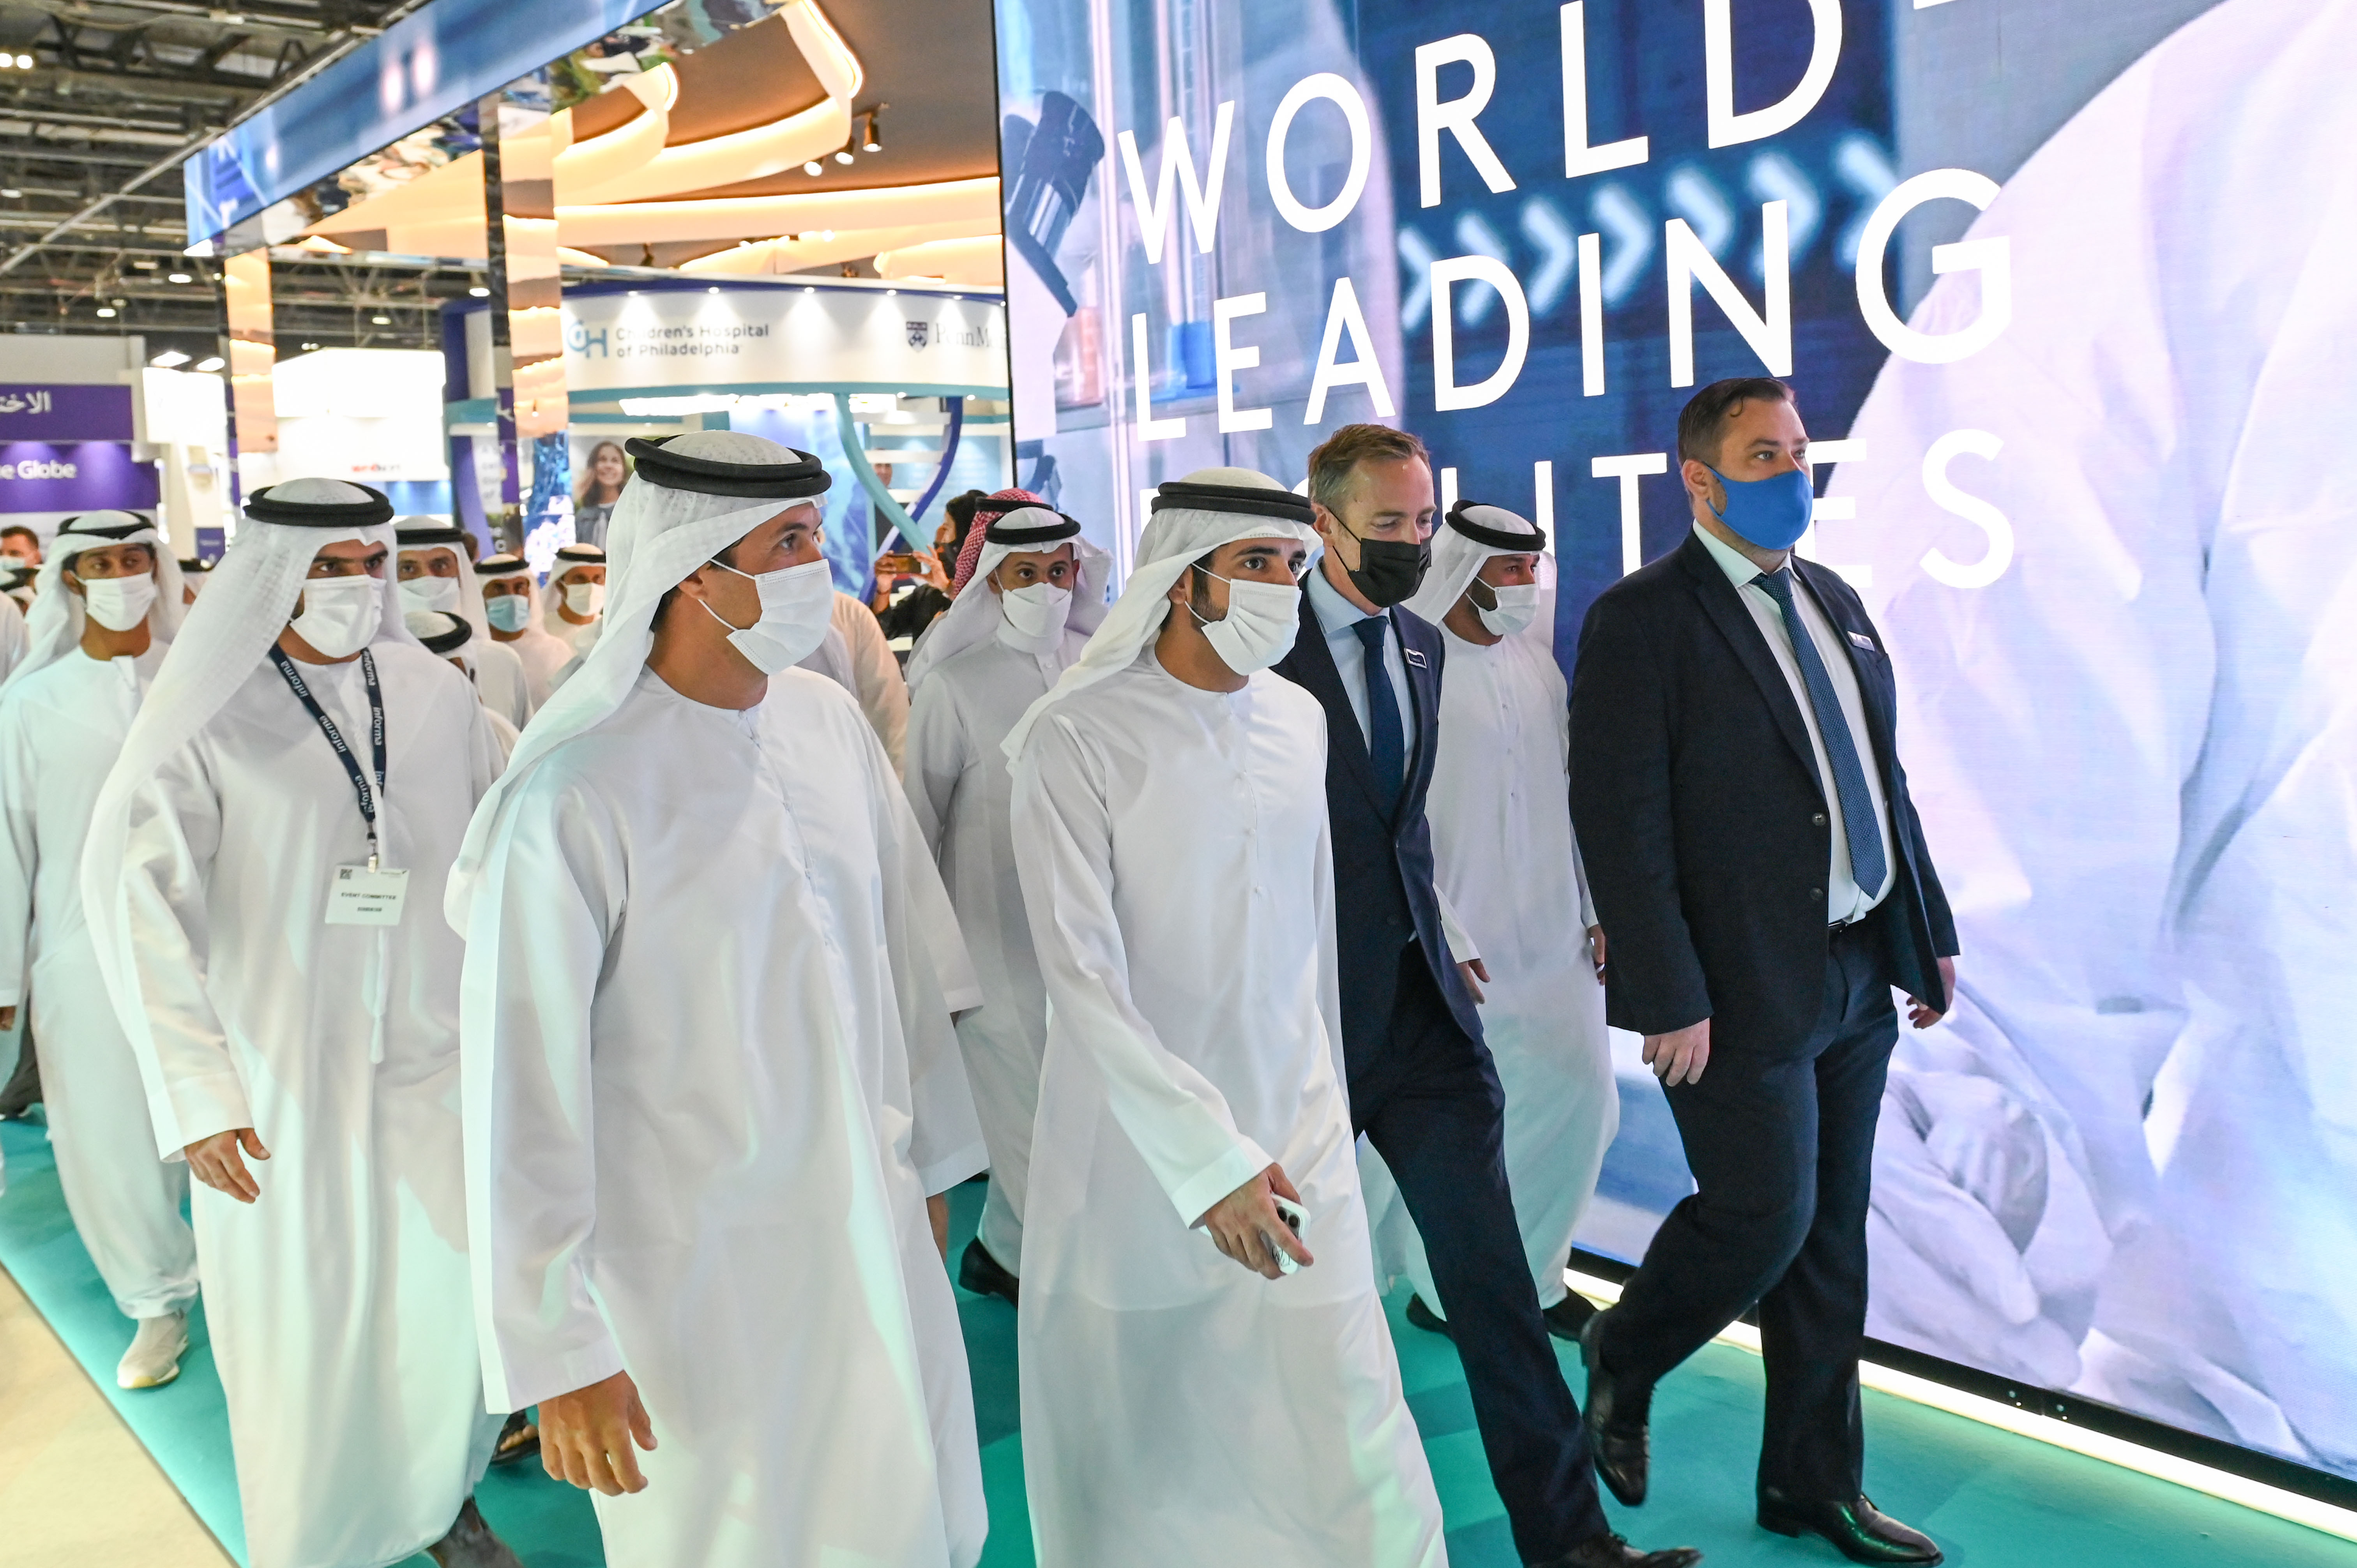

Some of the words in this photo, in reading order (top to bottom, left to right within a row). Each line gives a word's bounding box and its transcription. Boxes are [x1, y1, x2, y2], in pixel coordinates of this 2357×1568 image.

[1132, 168, 2011, 441] LEADING
[616, 346, 631, 358] of
[640, 341, 739, 357] Philadelphia
[700, 323, 770, 339] Hospital
[17, 459, 76, 479] Globe
[280, 661, 308, 698] informa
[319, 715, 346, 753] informa
[373, 706, 383, 746] informa
